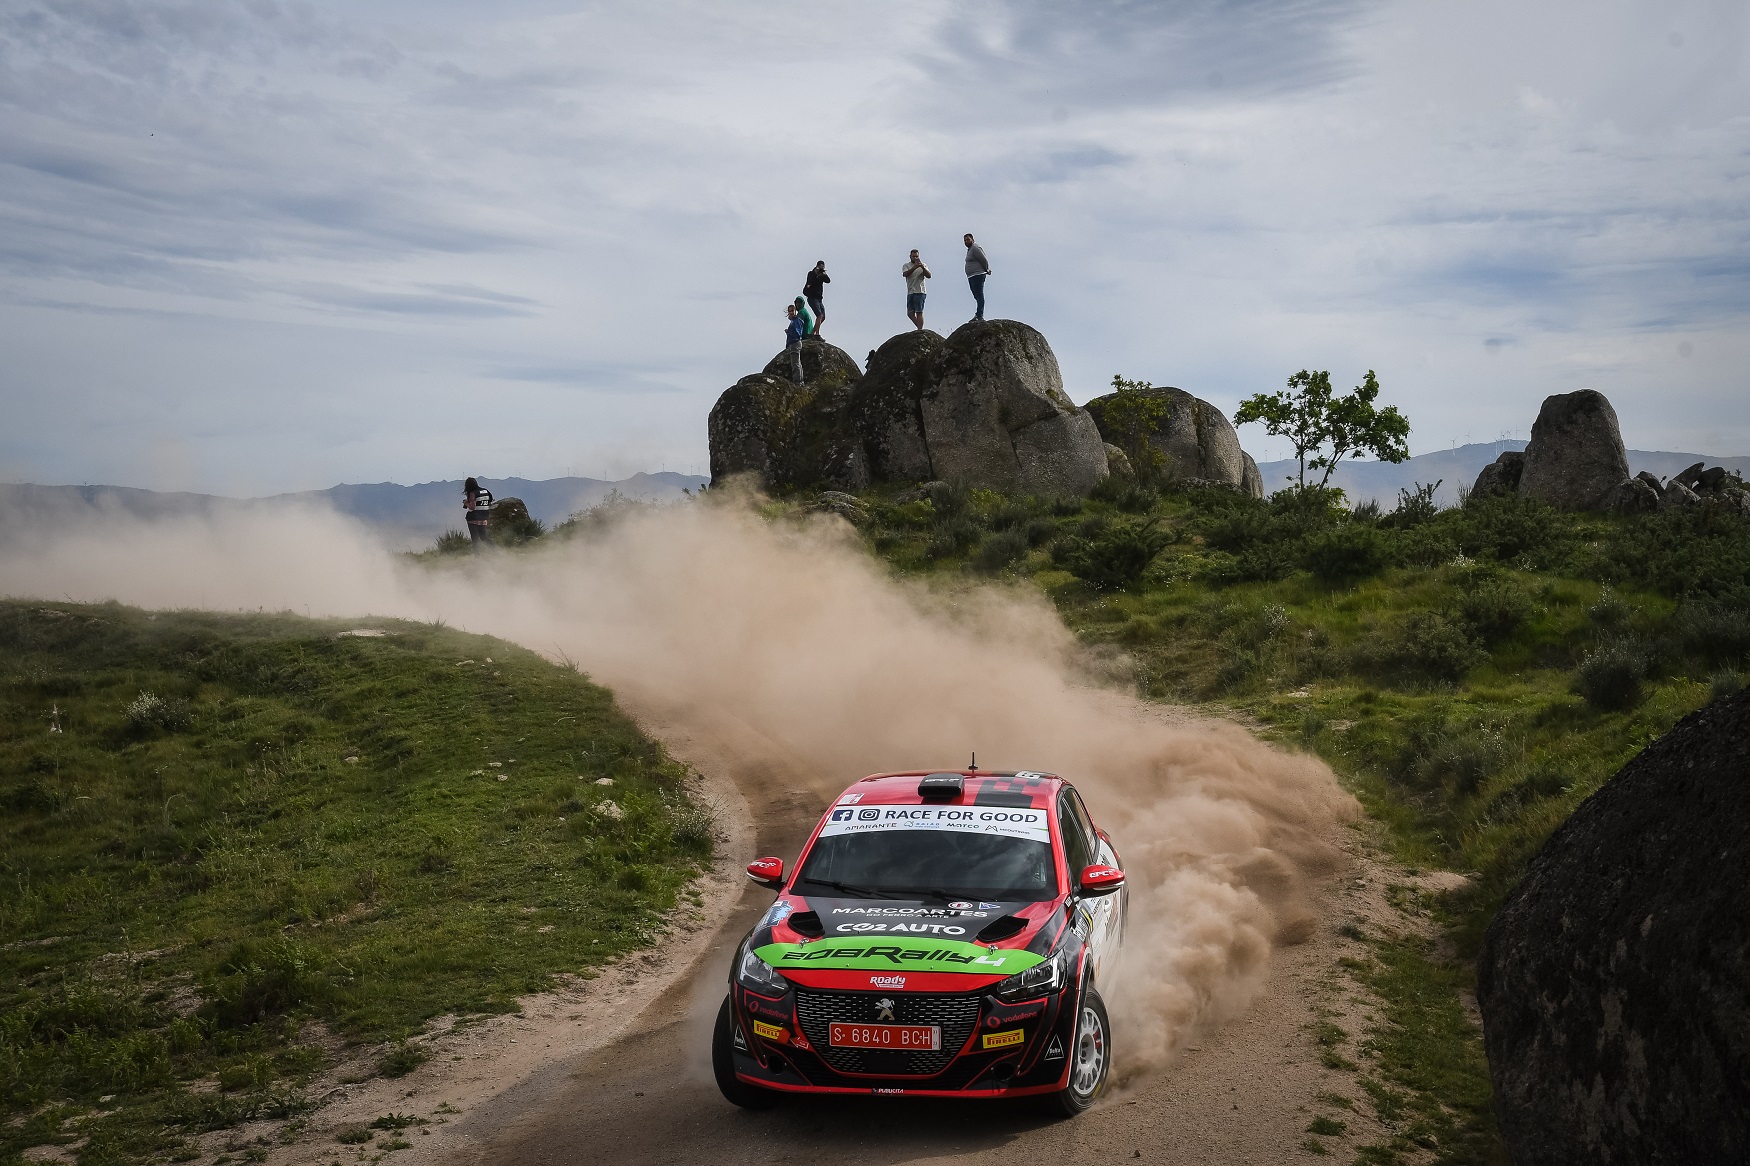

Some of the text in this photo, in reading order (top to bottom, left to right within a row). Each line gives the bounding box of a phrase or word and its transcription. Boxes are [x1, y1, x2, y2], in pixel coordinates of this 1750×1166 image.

[884, 810, 1039, 823] RACE FOR GOOD
[844, 822, 898, 831] AMARANTE
[832, 907, 989, 918] MARCOARTES
[836, 922, 966, 935] CO2 AUTO
[1003, 1010, 1039, 1023] vodafone
[851, 1028, 891, 1044] 6840
[901, 1030, 931, 1045] BCH
[986, 1031, 1021, 1046] PIRELLI
